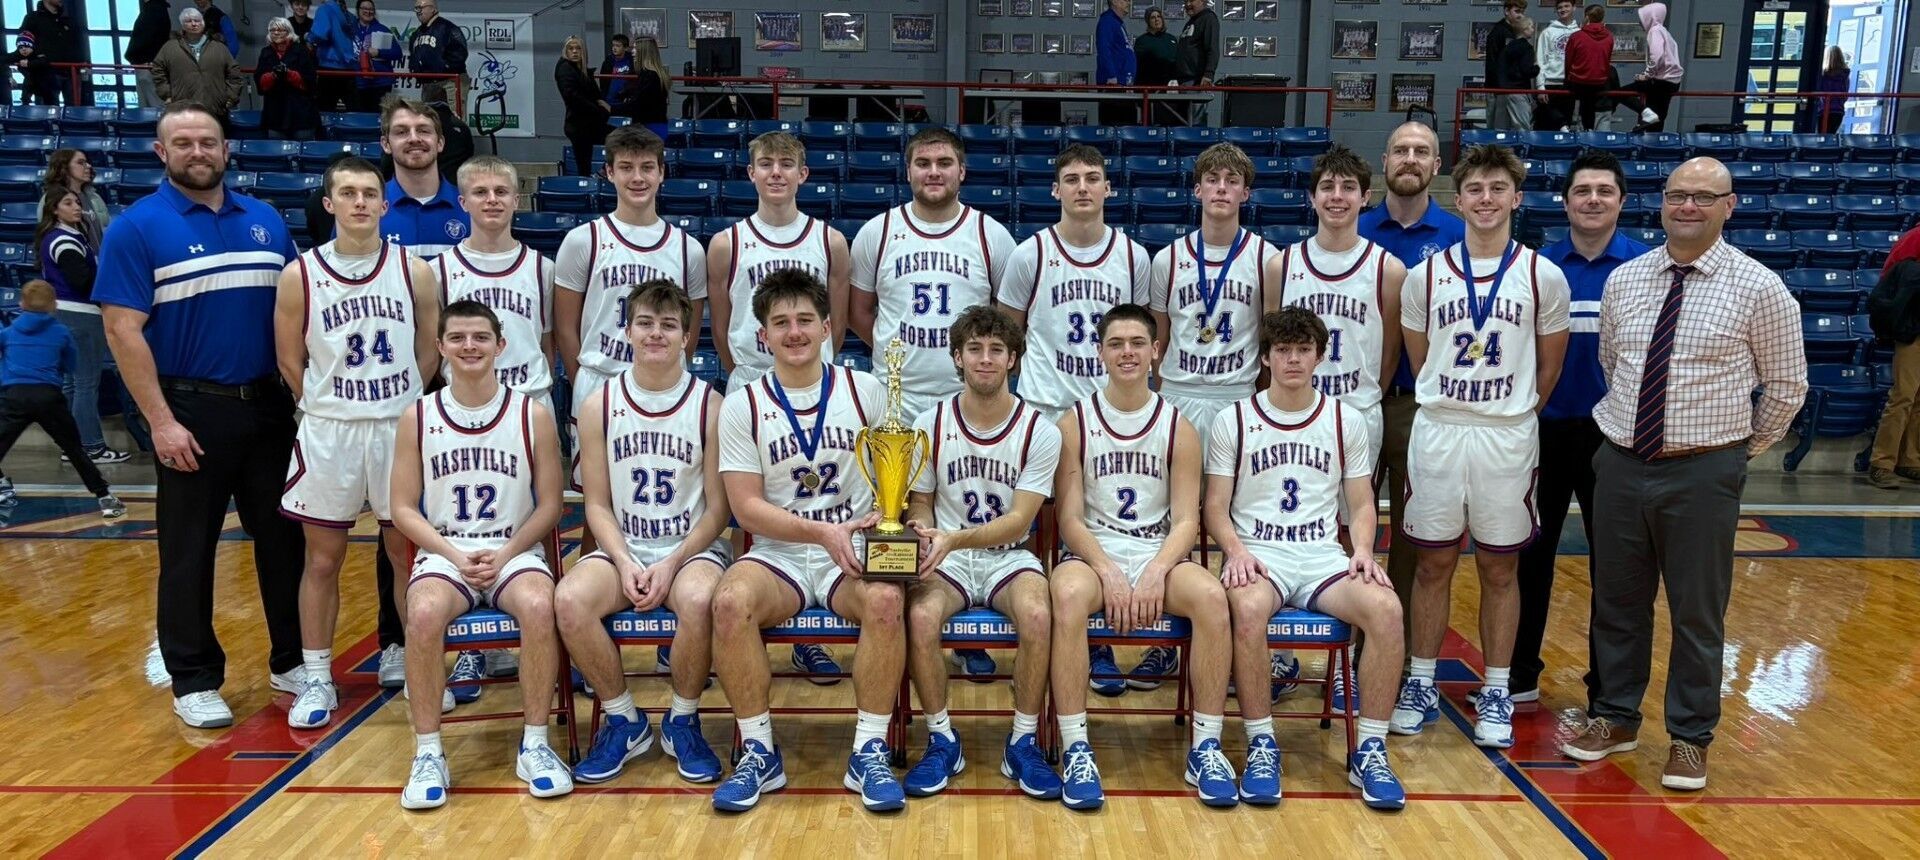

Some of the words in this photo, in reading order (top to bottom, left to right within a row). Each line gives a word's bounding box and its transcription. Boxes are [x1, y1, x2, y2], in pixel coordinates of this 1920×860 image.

[895, 251, 970, 280] NASHVILLE
[909, 282, 952, 317] 51
[1051, 278, 1122, 308] NASHVILLE
[321, 294, 406, 333] NASHVILLE
[1194, 311, 1234, 345] 14
[345, 328, 395, 369] 34
[600, 332, 634, 363] HORN
[900, 320, 948, 349] HORNE
[1328, 328, 1343, 363] 1
[1453, 330, 1503, 368] 24
[1056, 350, 1106, 378] HORNE
[1179, 347, 1245, 375] HORNETS
[333, 367, 410, 401] HORNETS
[1312, 368, 1361, 396] RNETS
[1439, 372, 1515, 402] HORNETS
[431, 447, 518, 480] NASHVILLE
[613, 431, 694, 466] NASHVILLE
[1251, 441, 1332, 476] NASHVILLE
[630, 466, 677, 508] 25
[790, 460, 841, 500] 22
[947, 454, 1018, 489] NASHVILLE
[452, 483, 498, 522] 12
[963, 489, 1005, 524] 23
[1116, 486, 1138, 522] 2
[1279, 476, 1302, 514] 3
[622, 506, 691, 539] HORNETS
[1252, 516, 1326, 542] HORNETS
[447, 623, 468, 637] GO
[471, 620, 497, 634] BIG
[500, 619, 520, 632] BL
[612, 619, 633, 632] GO
[634, 619, 659, 632] BIG
[661, 619, 677, 631] BL
[797, 617, 821, 629] BIG
[954, 622, 977, 634] BIG
[980, 623, 1017, 635] BLUE
[1087, 618, 1105, 630] GO
[1267, 624, 1291, 635] BIG
[1294, 624, 1332, 636] BLUE
